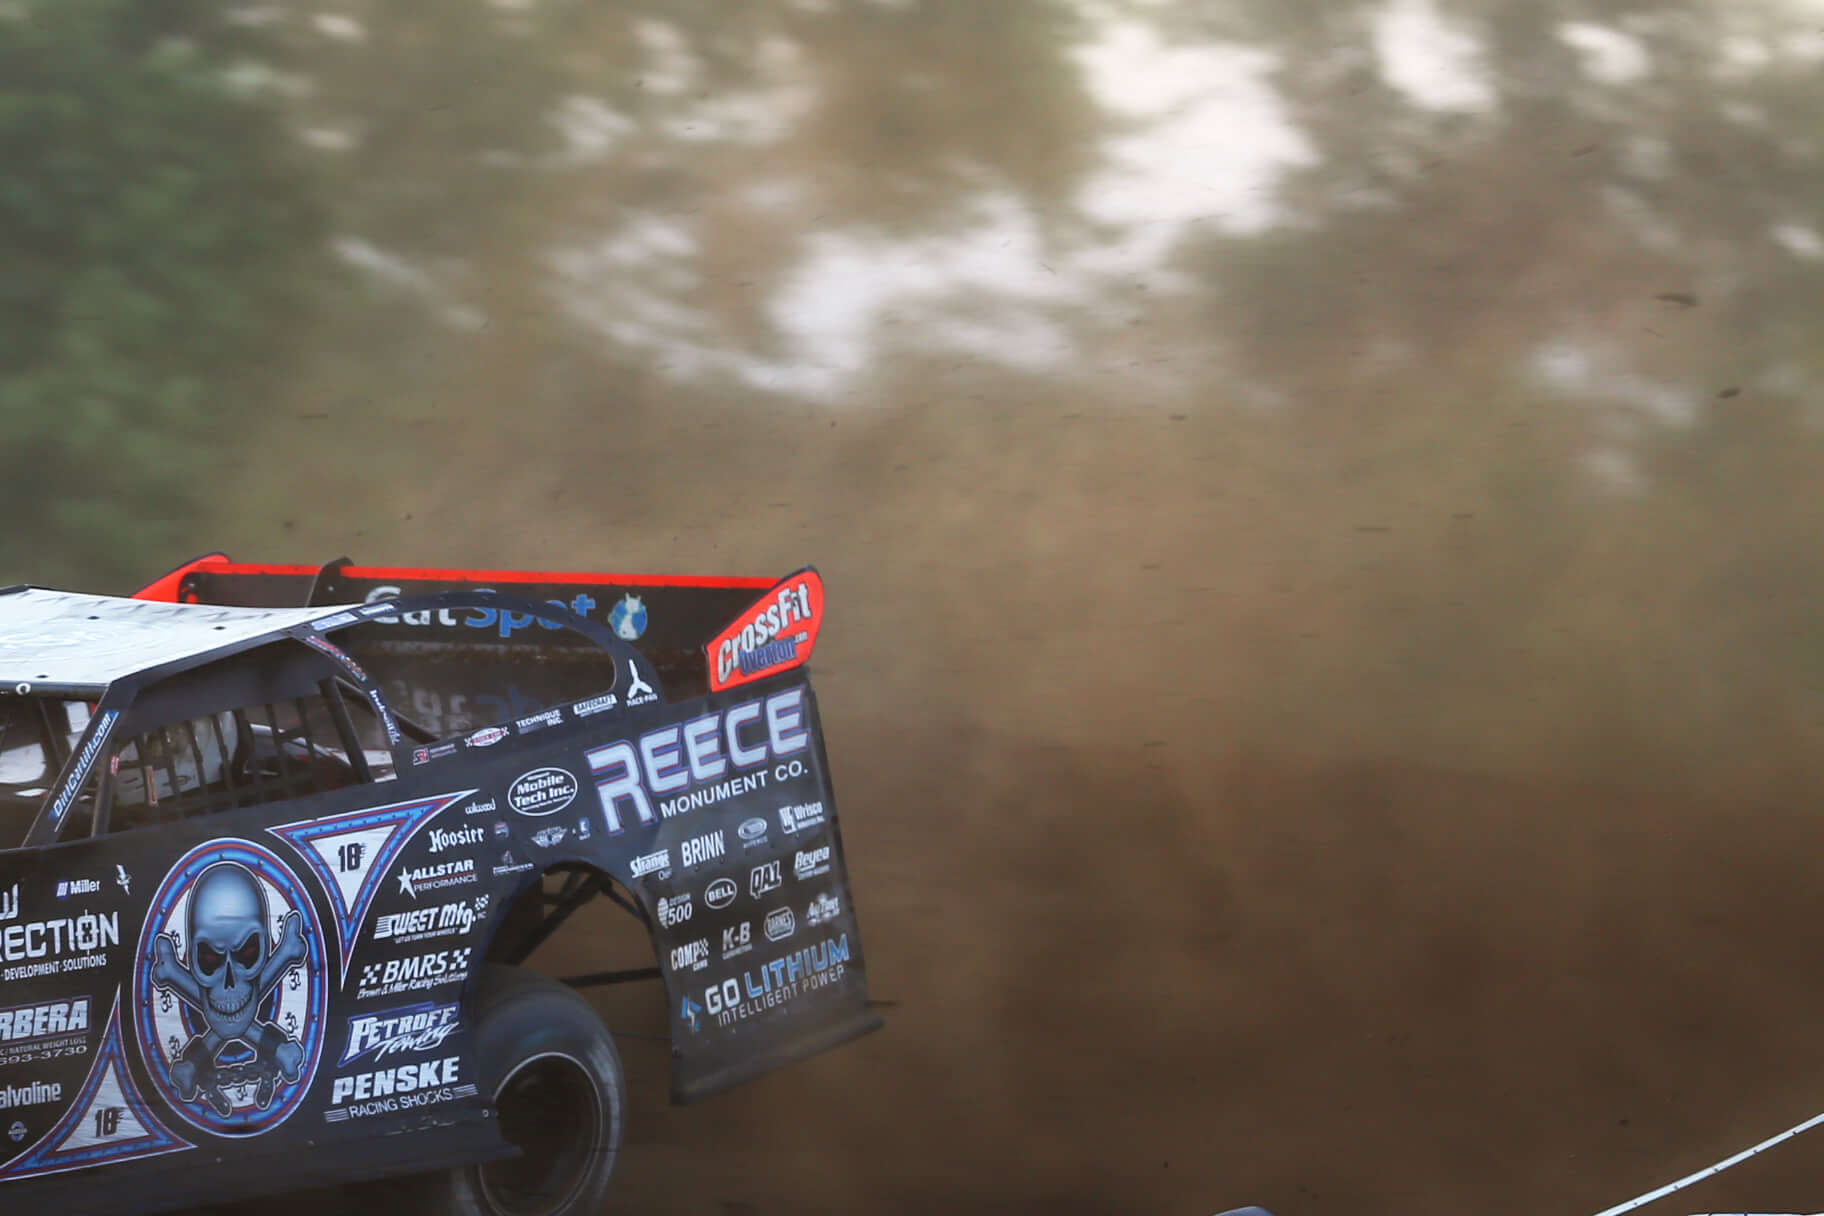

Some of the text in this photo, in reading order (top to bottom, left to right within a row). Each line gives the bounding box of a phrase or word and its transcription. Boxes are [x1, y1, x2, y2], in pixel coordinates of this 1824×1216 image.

[717, 583, 812, 684] CrossFit
[516, 709, 561, 729] TECHNIQUE
[584, 685, 811, 836] REECE
[514, 791, 547, 807] Tech
[549, 784, 575, 798] Inc.
[517, 775, 565, 795] Mobile
[660, 760, 809, 818] MONUMENT CO.
[429, 824, 485, 853] Hoosier
[681, 829, 725, 868] BRINN
[411, 859, 474, 881] ALLSTAR
[413, 873, 479, 892] PERFORMANCE
[70, 879, 101, 895] Miller
[707, 885, 735, 902] BELL
[374, 907, 440, 939] SWEET
[667, 902, 693, 926] 500
[382, 951, 449, 983] BMRS
[670, 941, 700, 971] COMP
[704, 933, 850, 1016] GO LITHIUM
[718, 964, 845, 1027] INTELLIGENT POWER
[344, 1006, 457, 1061] PETROFF
[372, 1022, 461, 1062] Towing
[331, 1056, 460, 1105] PENSKE
[348, 1088, 454, 1118] RACING SHOCKS
